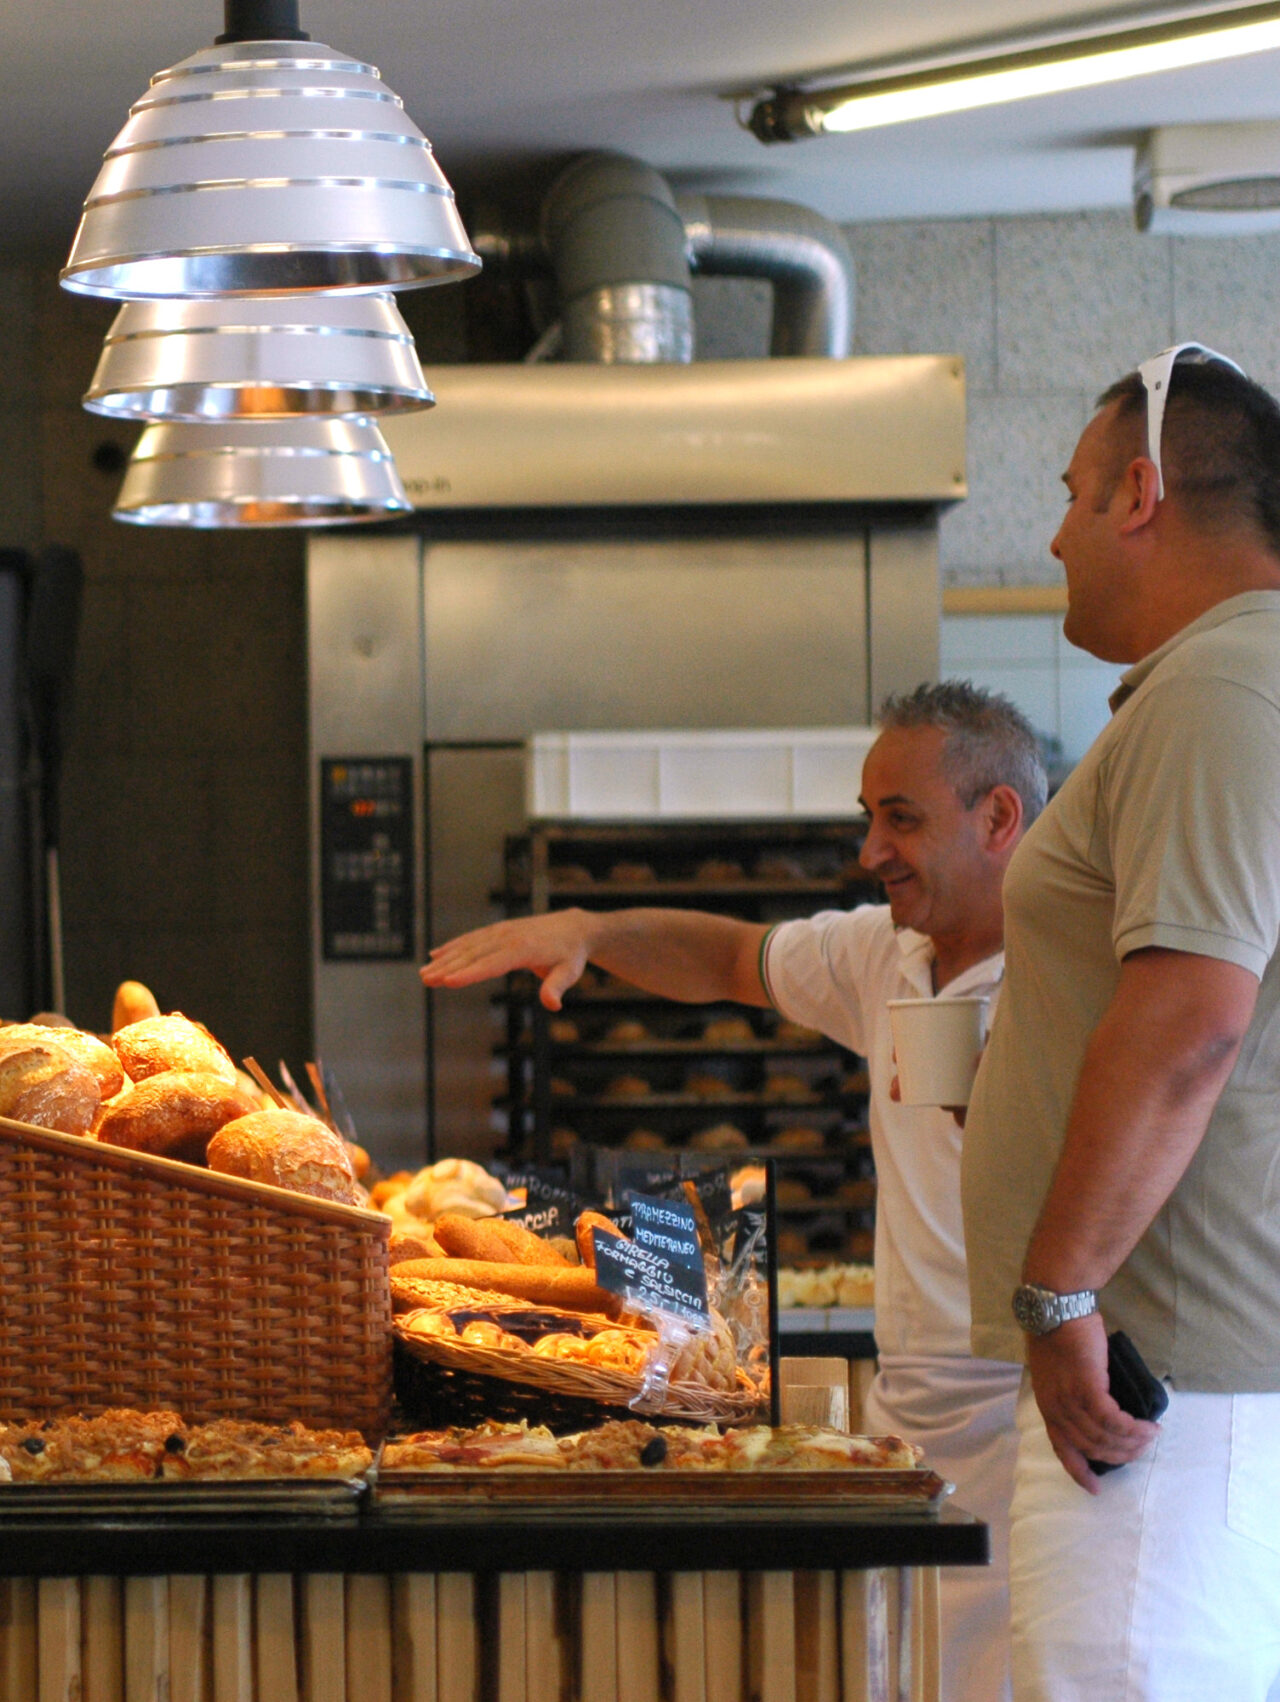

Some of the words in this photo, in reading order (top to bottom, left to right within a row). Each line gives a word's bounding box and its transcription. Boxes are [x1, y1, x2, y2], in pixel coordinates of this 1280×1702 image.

[595, 1240, 673, 1284] FORMAGGIO
[617, 1239, 670, 1269] GIRELLA
[640, 1275, 702, 1310] SALSICCIA
